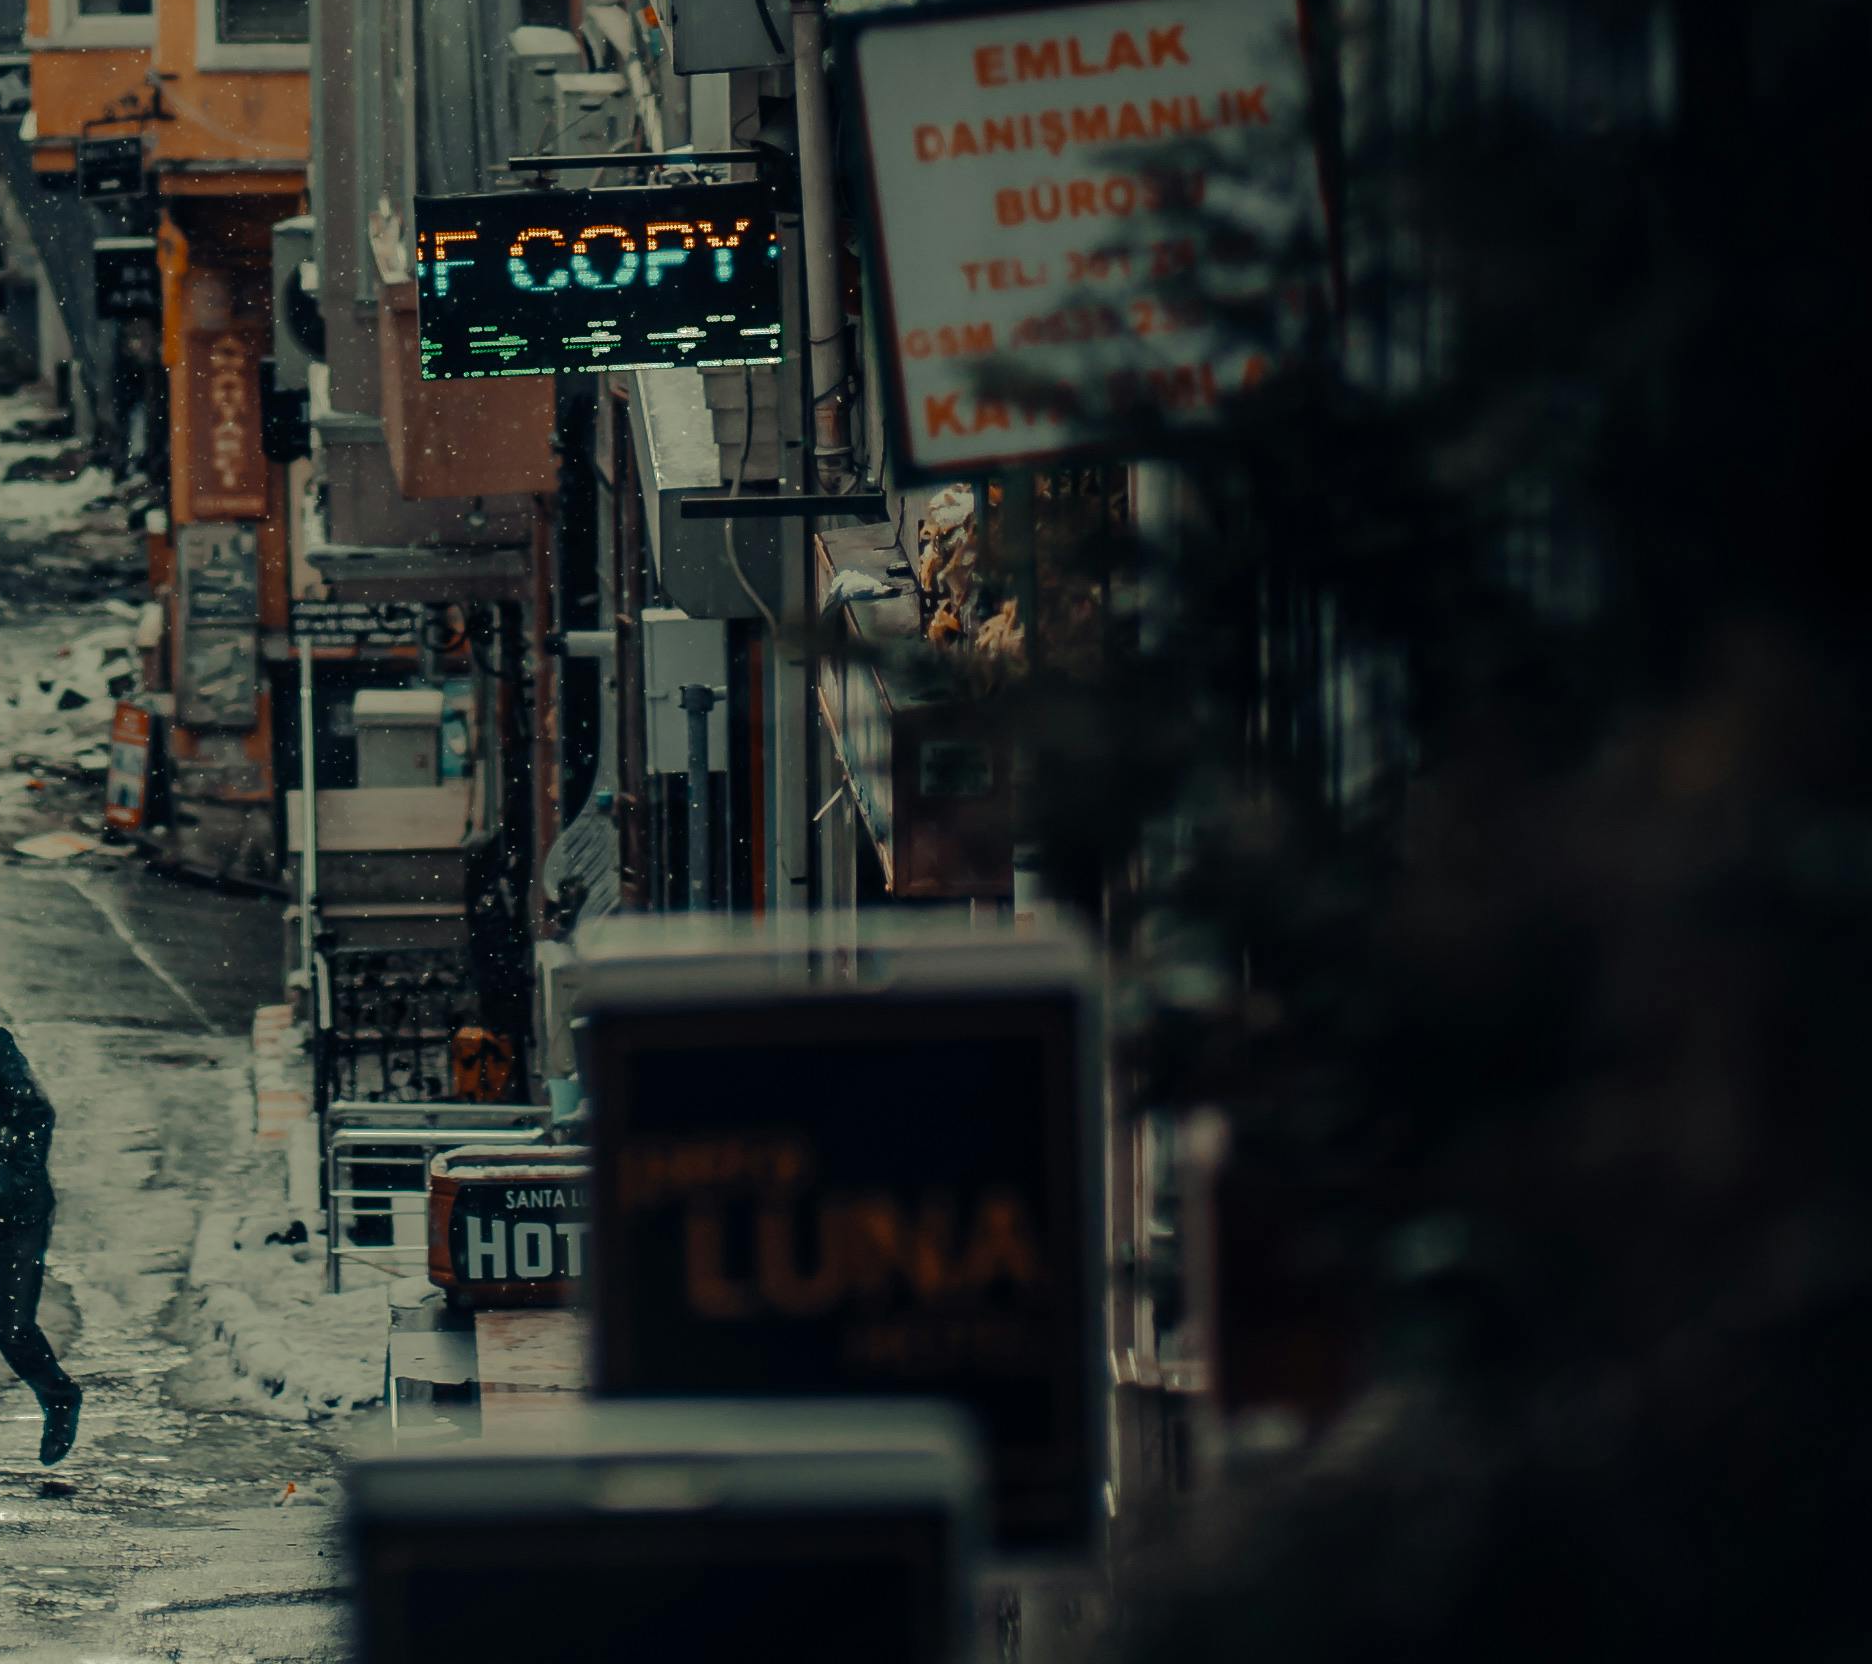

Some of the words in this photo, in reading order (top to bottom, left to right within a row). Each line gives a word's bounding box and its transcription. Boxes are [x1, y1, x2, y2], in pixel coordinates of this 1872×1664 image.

[973, 24, 1191, 88] EMLAK
[912, 85, 1269, 163] DANIŞMANLIK
[417, 230, 478, 298] F
[507, 219, 752, 293] COPY
[905, 322, 995, 359] GSM
[504, 1189, 566, 1210] SANTA
[465, 1215, 592, 1280] HOT
